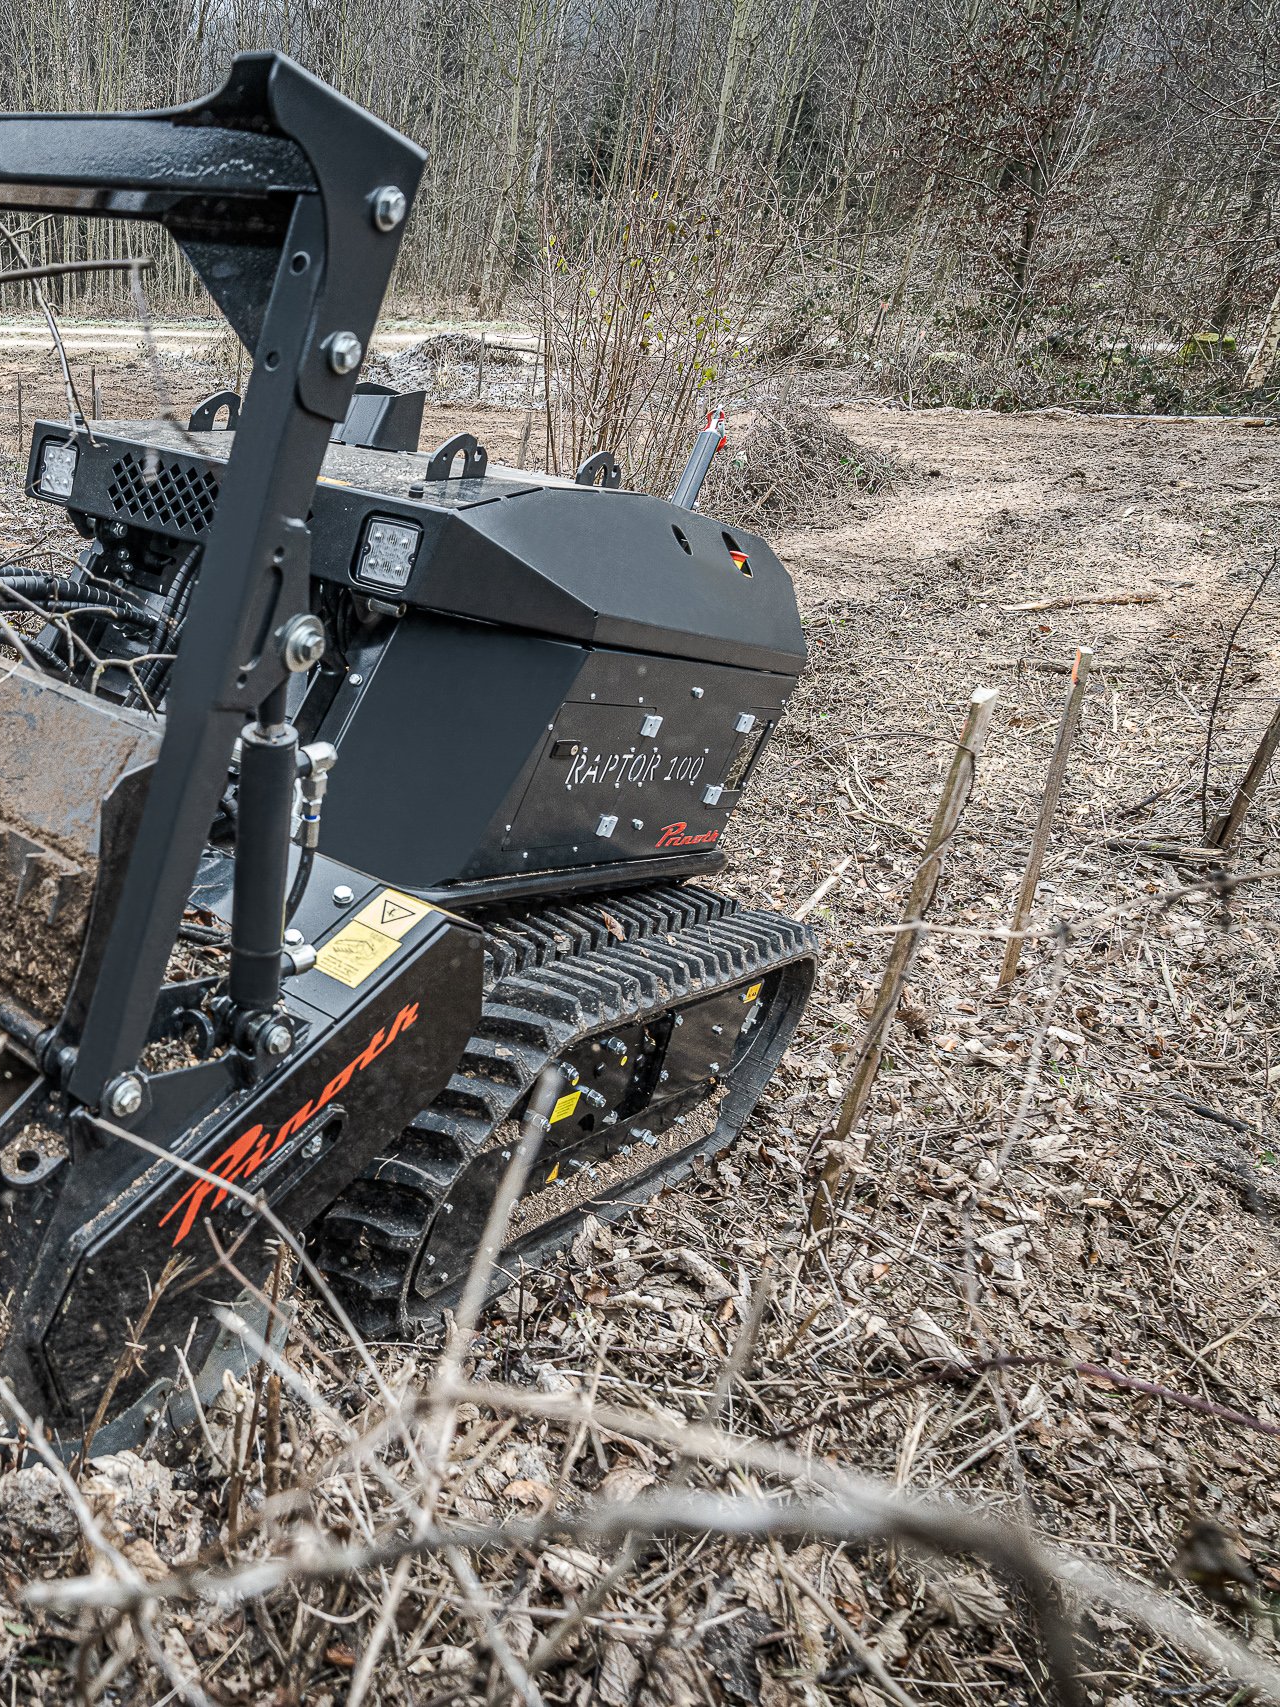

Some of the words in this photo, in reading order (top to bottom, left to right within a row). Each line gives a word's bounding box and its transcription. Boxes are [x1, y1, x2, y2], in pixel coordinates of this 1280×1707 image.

[565, 753, 662, 784] RAPTOR
[664, 756, 706, 782] 100
[655, 822, 719, 848] Prinoth
[158, 1002, 419, 1248] Prinoth
